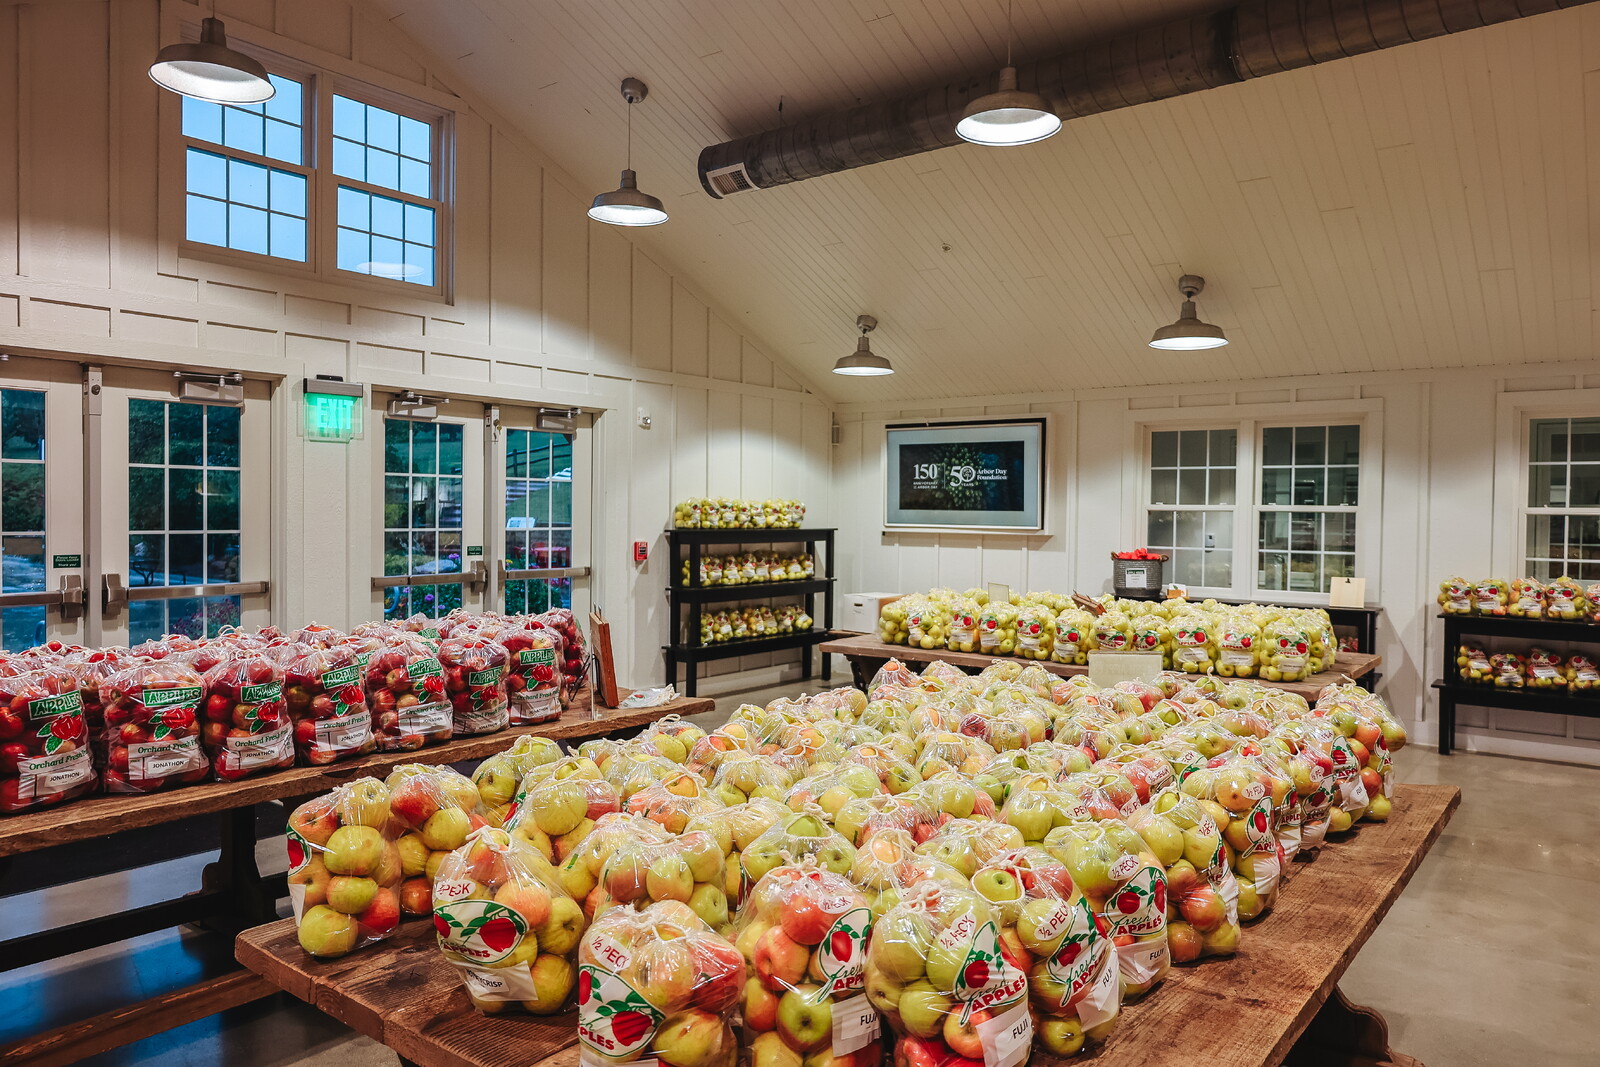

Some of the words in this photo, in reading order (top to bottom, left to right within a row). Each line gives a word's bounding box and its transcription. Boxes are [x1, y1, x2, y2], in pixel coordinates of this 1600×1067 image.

[316, 397, 354, 430] EXIT
[995, 468, 1008, 476] Day
[521, 650, 555, 664] APPLES
[147, 689, 200, 705] APPLES
[323, 718, 351, 729] Orchard
[351, 715, 364, 725] Fresh
[138, 743, 171, 754] Orchard
[234, 738, 263, 747] Orchard
[245, 750, 275, 758] JONATHON
[29, 757, 64, 771] Orchard
[152, 760, 184, 769] JONATHON
[50, 771, 80, 783] JONATHON
[1281, 813, 1301, 823] APPLE
[1119, 856, 1139, 874] PECK
[1117, 915, 1162, 936] APPLES
[443, 943, 491, 958] APPLES
[1149, 947, 1165, 960] FUJI
[972, 975, 1026, 1012] APPLES
[860, 1012, 878, 1026] FUJI
[1012, 1018, 1029, 1039] FUJI
[578, 1022, 614, 1050] PLES
